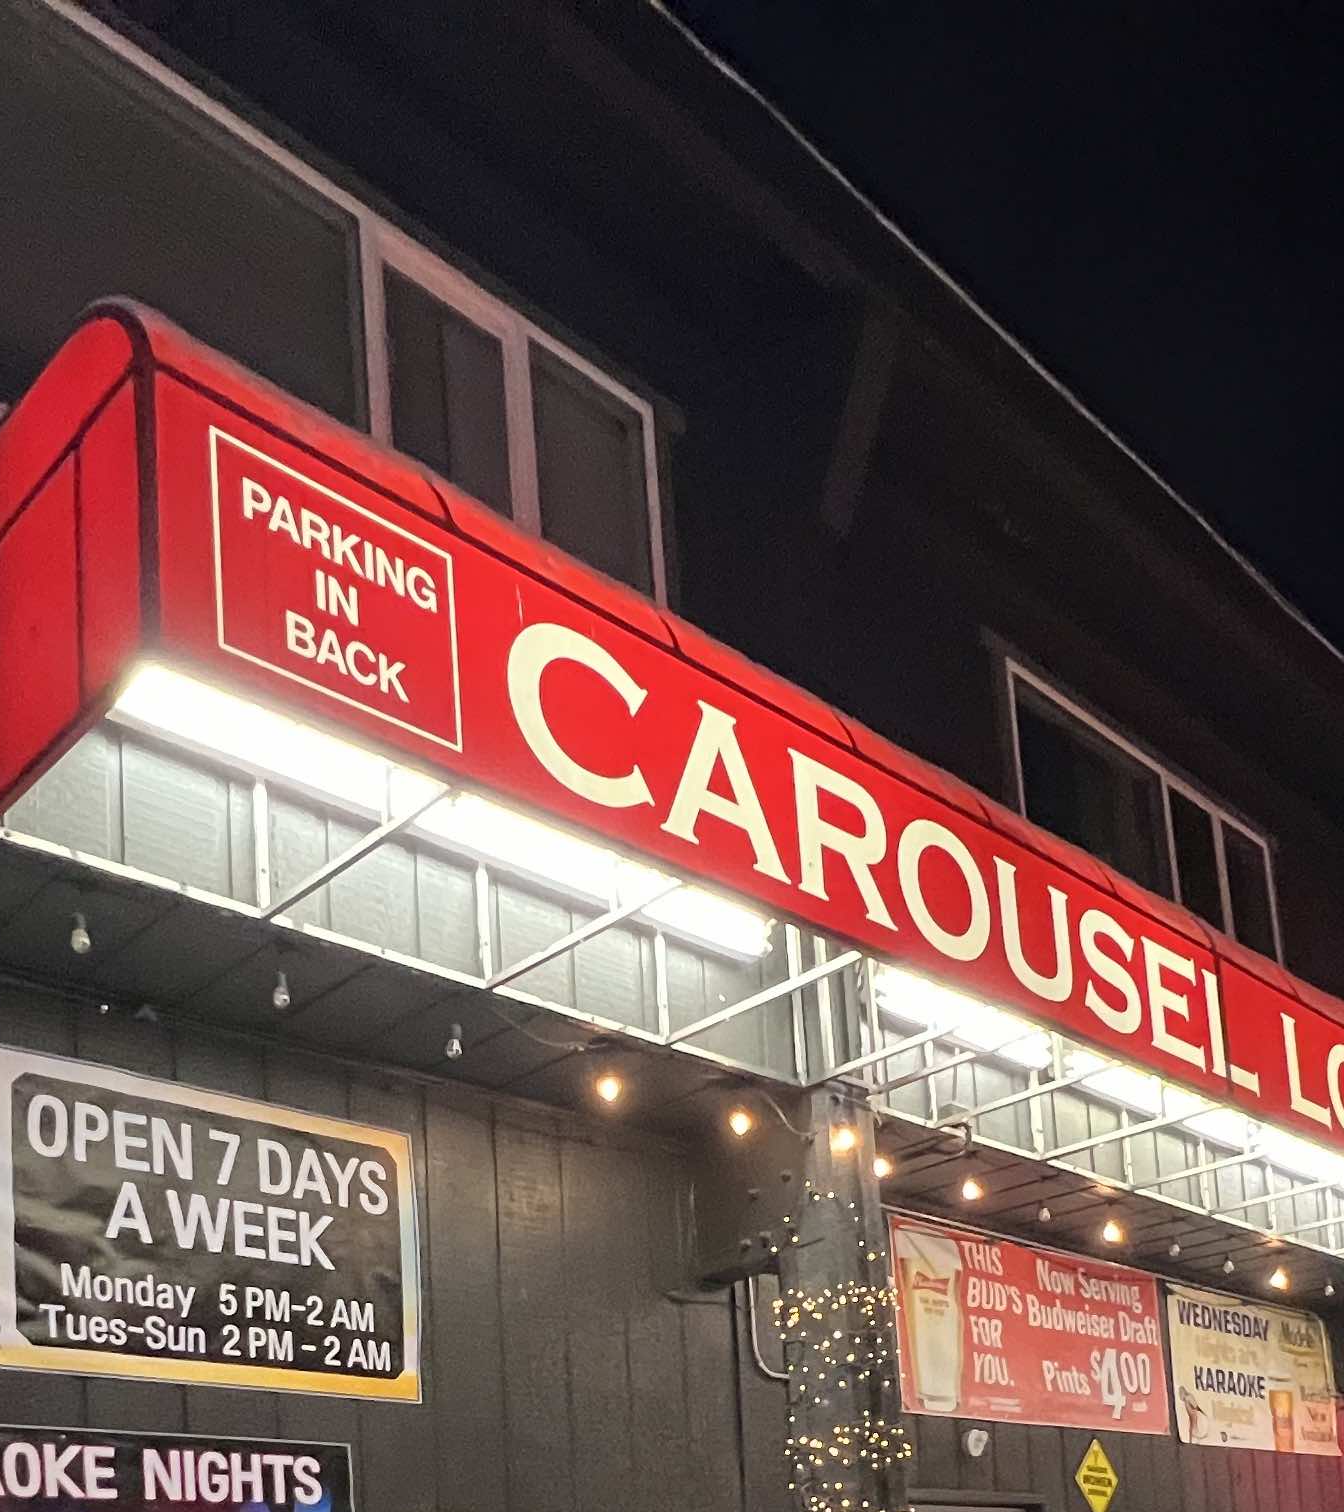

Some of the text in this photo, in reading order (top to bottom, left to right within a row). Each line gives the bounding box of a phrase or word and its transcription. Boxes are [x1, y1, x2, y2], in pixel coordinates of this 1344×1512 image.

[242, 477, 438, 613] PARKING
[315, 570, 360, 627] IN
[286, 609, 410, 705] BACK
[506, 622, 1260, 1098] CAROUSEL
[27, 1093, 389, 1216] OPEN 7 DAYS
[105, 1181, 336, 1271] A WEEK
[960, 1240, 1004, 1276] THIS
[1036, 1258, 1143, 1314] Now Serving
[60, 1262, 197, 1318] Monday
[219, 1283, 238, 1317] 5
[330, 1298, 376, 1333] AM
[967, 1276, 1024, 1315] BUD'S
[1026, 1294, 1158, 1346] Budweiser Draft
[1177, 1299, 1269, 1341] WEDNESDAY
[39, 1303, 207, 1354] Tues-Sun
[222, 1324, 242, 1357] 2
[248, 1327, 294, 1363] PM
[323, 1335, 342, 1368] 2
[347, 1339, 391, 1373] AM
[970, 1315, 1003, 1348] FOR
[973, 1351, 1015, 1387] YOU.
[1042, 1359, 1091, 1396] Pints
[1194, 1365, 1265, 1400] KARAOKE
[143, 1447, 324, 1505] NIGHTS
